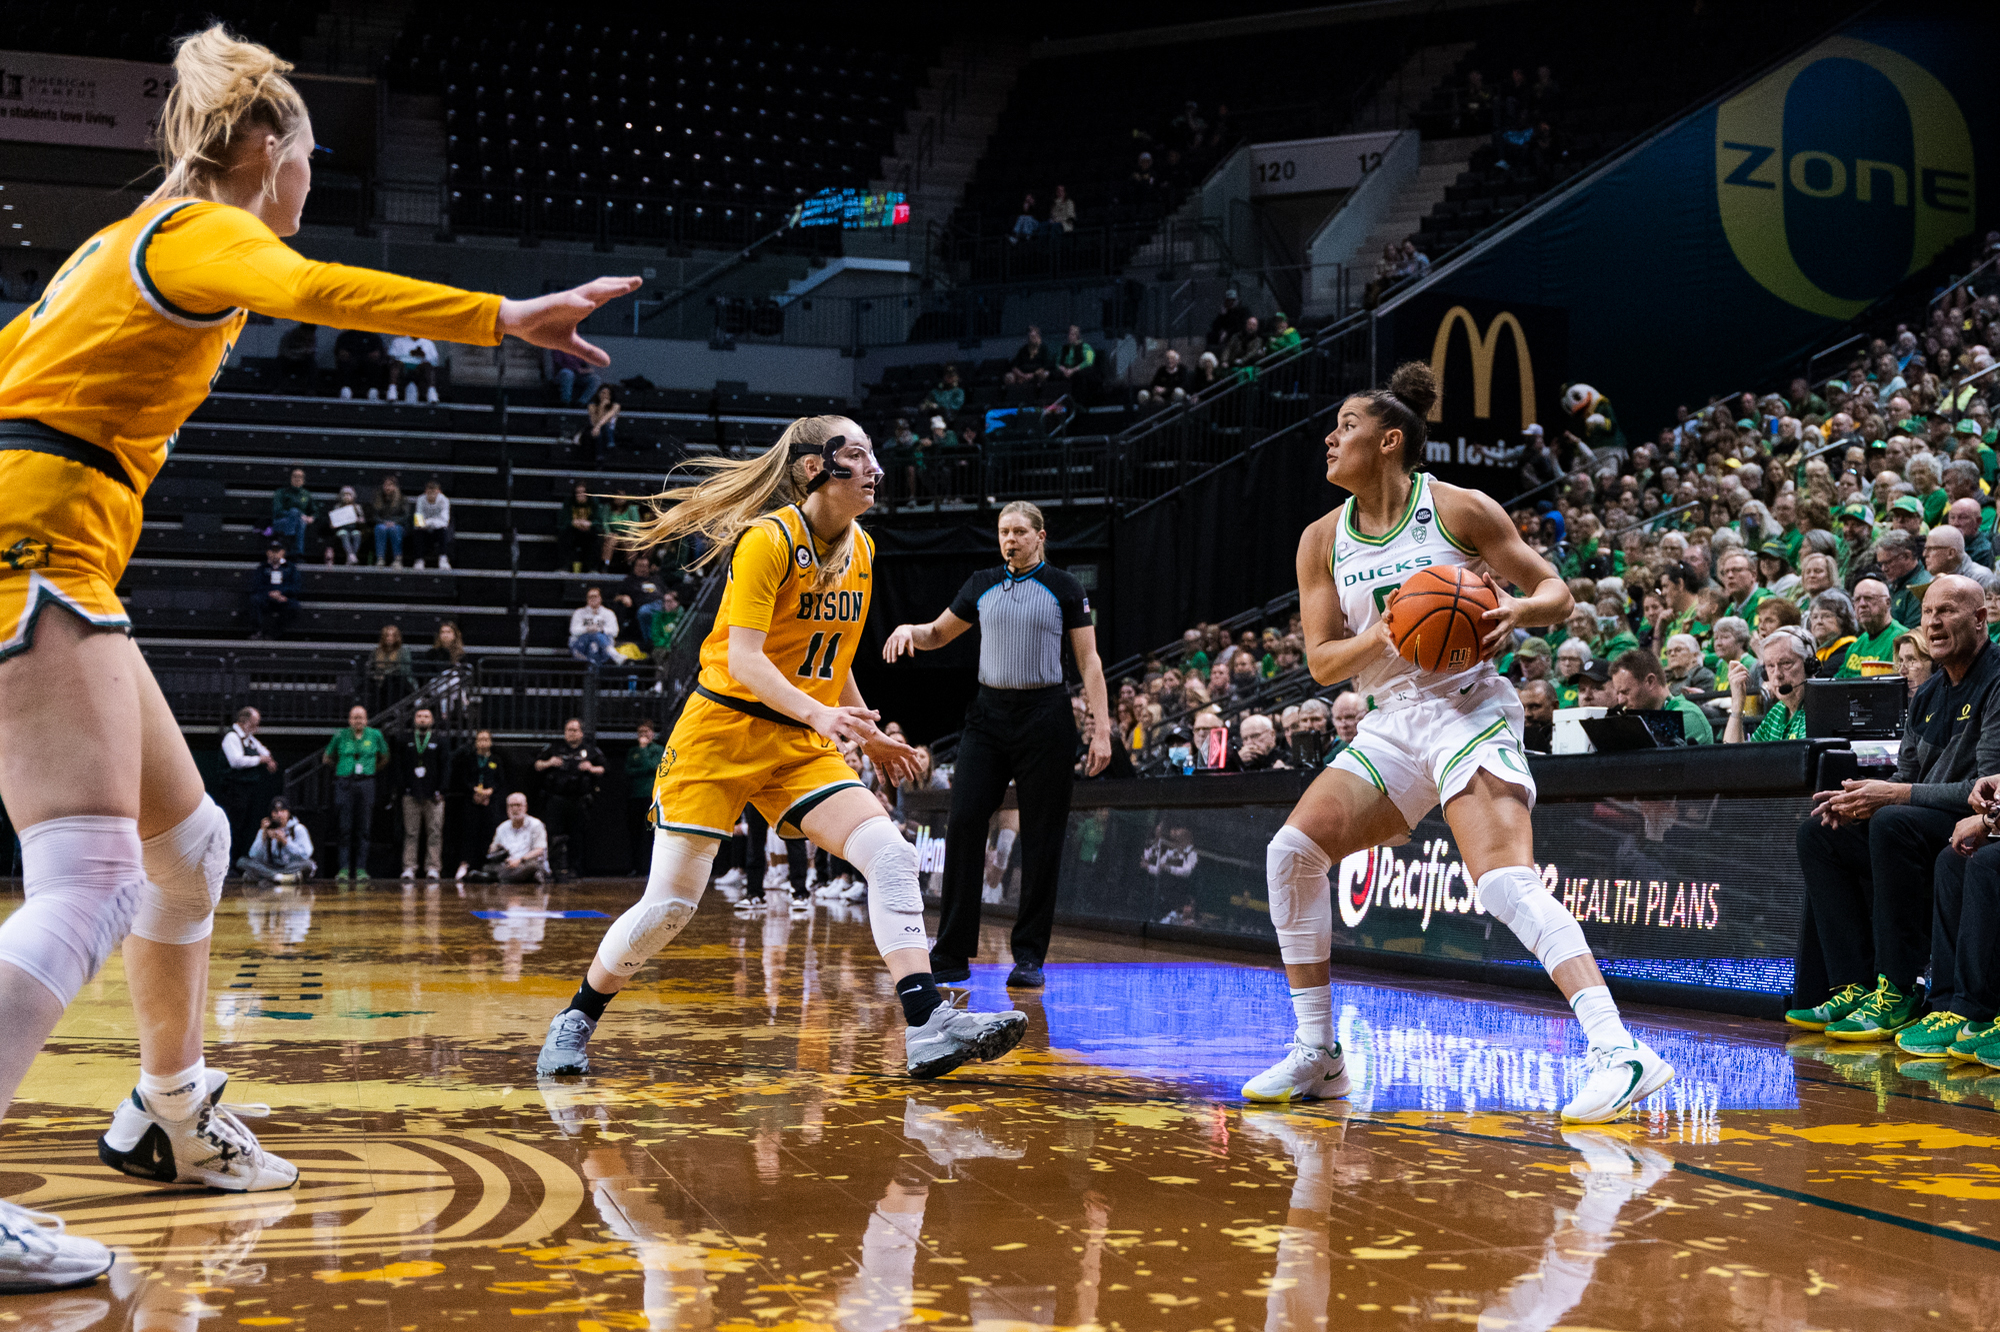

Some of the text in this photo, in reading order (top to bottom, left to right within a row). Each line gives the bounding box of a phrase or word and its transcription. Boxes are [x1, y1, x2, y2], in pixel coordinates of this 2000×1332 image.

[9, 106, 57, 121] students
[60, 109, 83, 124] love
[1257, 161, 1296, 183] 120
[1344, 555, 1433, 587] DUCKS
[796, 590, 864, 622] BISON
[796, 631, 844, 681] 11
[1562, 878, 1641, 925] HEALTH
[1645, 880, 1721, 930] PLANS
